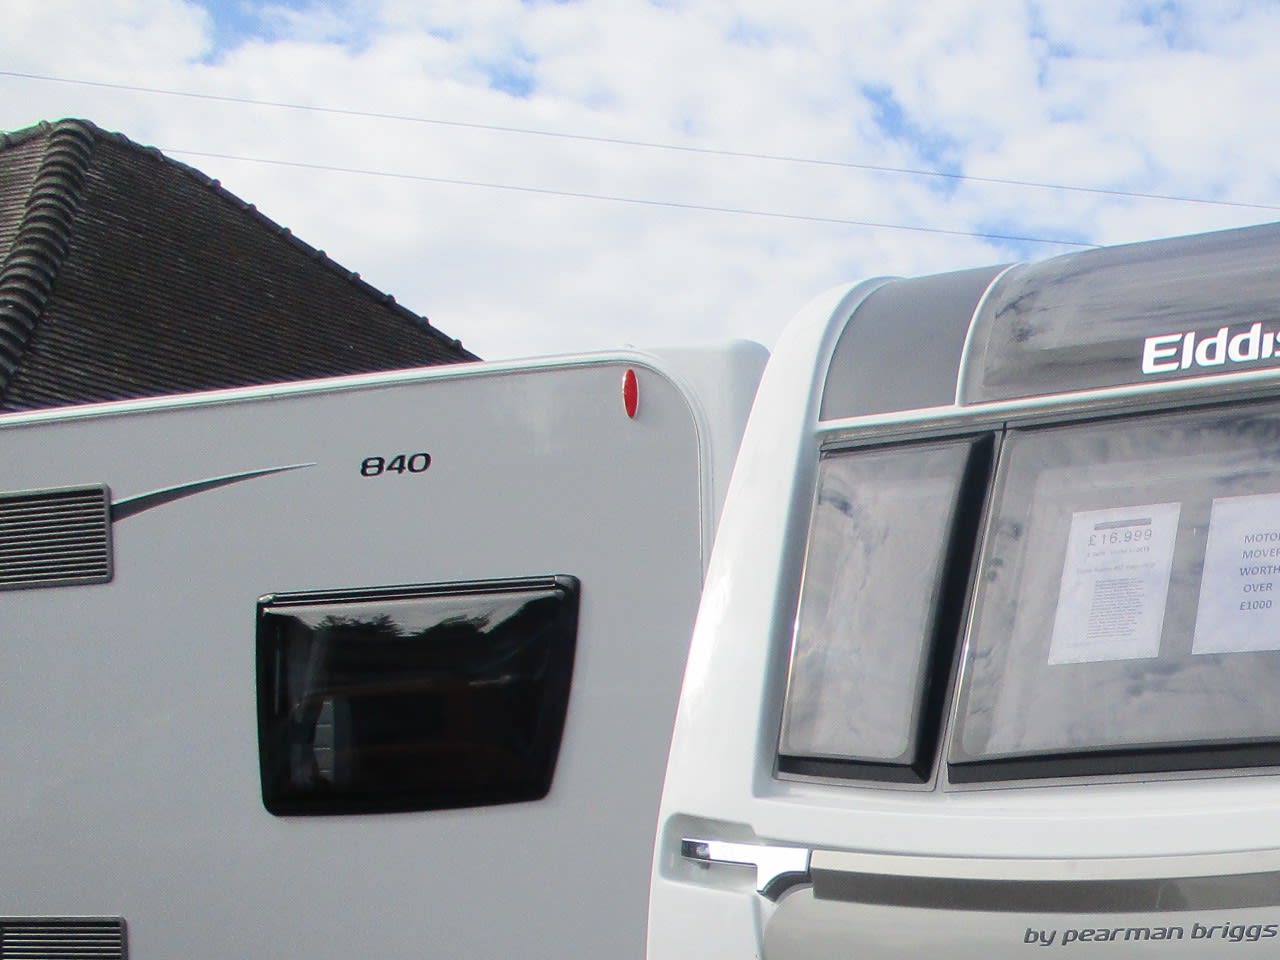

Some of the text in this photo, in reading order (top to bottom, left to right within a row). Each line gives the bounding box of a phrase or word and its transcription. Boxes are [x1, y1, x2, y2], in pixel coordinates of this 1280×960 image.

[360, 453, 432, 477] 840
[1239, 564, 1280, 576] WORTH
[1243, 582, 1273, 593] OVER
[1239, 600, 1272, 611] £1000
[1023, 921, 1279, 947] by pearman briggs
